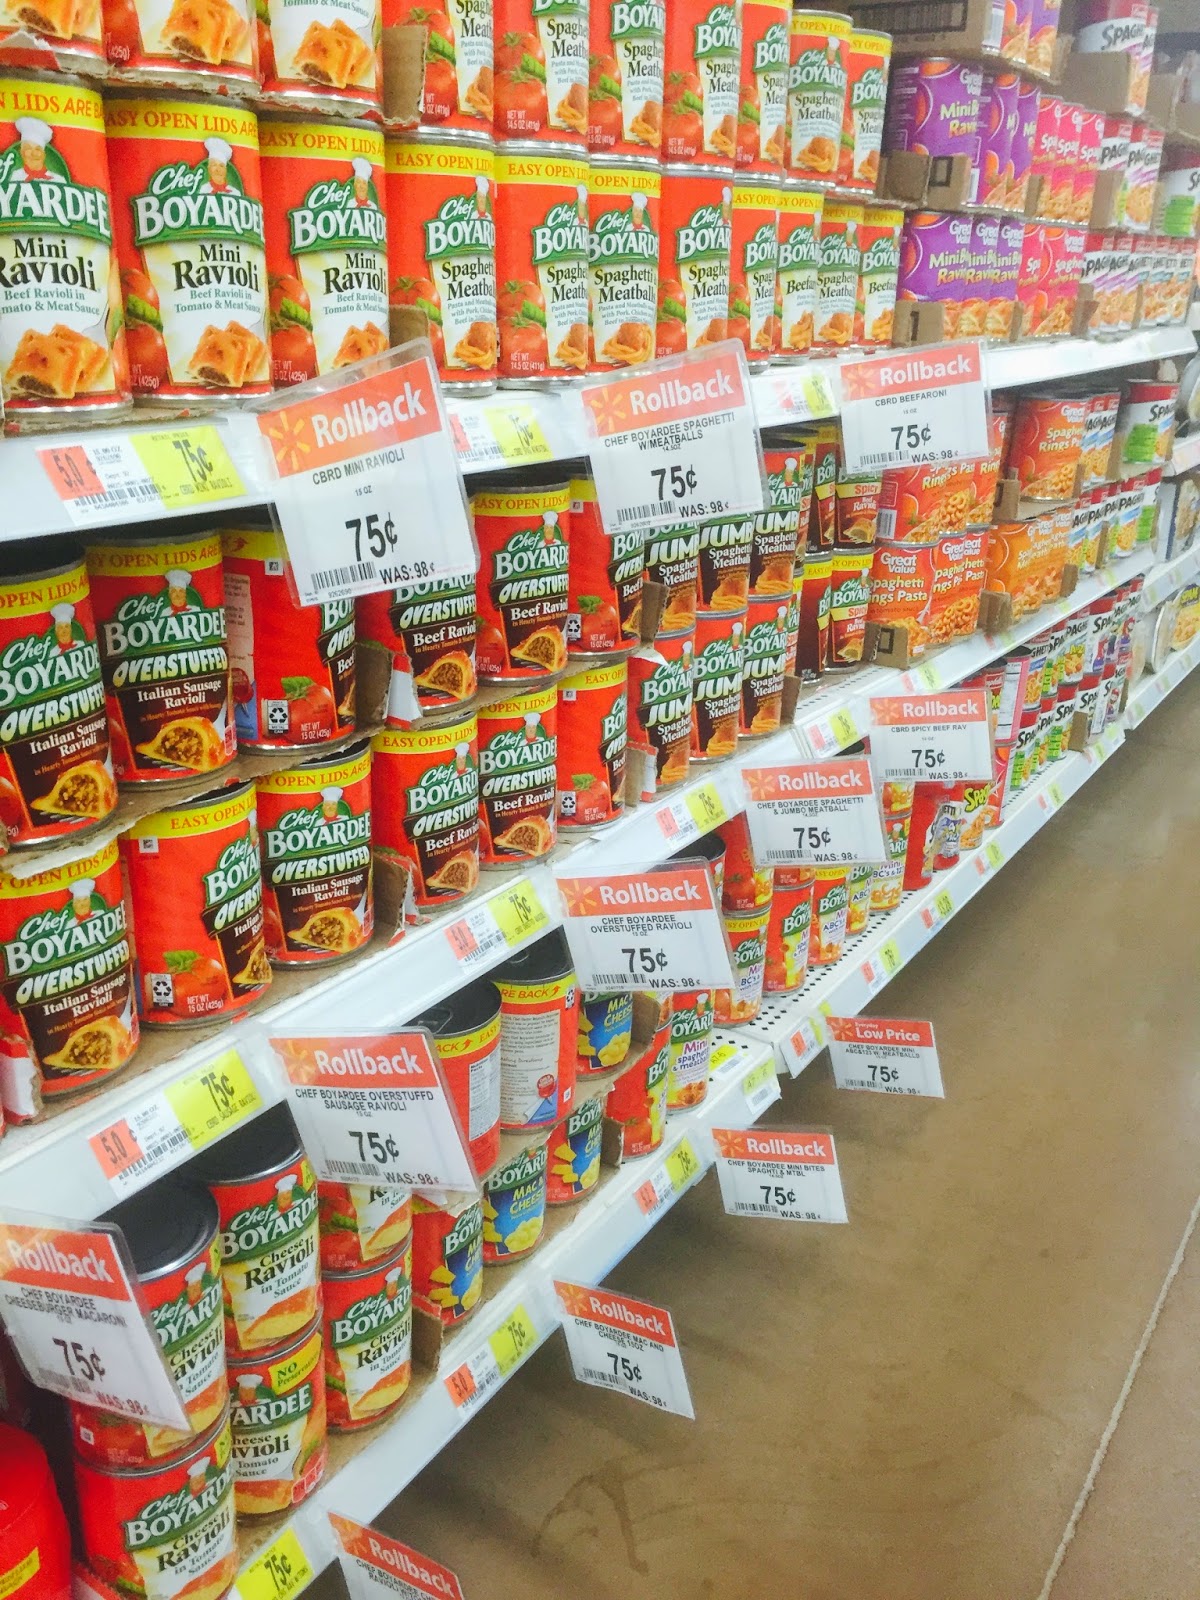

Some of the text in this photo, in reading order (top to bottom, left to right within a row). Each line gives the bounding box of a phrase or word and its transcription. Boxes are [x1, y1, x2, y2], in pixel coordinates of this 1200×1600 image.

[709, 7, 732, 25] Chef
[799, 50, 825, 66] Chef
[13, 92, 59, 112] LIDS
[144, 111, 237, 134] OPEN LIDS
[303, 135, 347, 151] OPEN
[396, 153, 473, 170] EASY OPEN
[508, 163, 542, 176] EASY
[152, 165, 202, 195] Chef
[595, 176, 629, 188] OPEN
[308, 183, 350, 209] Chef
[0, 183, 110, 237] YARDEE
[441, 200, 473, 220] Chef
[691, 206, 720, 228] Chef
[596, 212, 629, 233] Chef
[789, 228, 811, 243] Chef
[14, 237, 67, 260] Mini
[200, 244, 241, 263] Mini
[345, 253, 376, 271] Mini
[172, 259, 260, 293] Ravioli
[594, 265, 653, 285] Spaghetti
[880, 354, 972, 387] Rollback
[138, 376, 159, 389] (425g)
[630, 369, 734, 416] Rollback
[875, 390, 947, 407] CBRD BEEFARONI
[312, 382, 427, 448] Rollback
[604, 412, 735, 448] CHEF BOYARDEE SPAGHETTI
[891, 423, 932, 450] 75¢
[638, 430, 703, 451] W/MEATBALLS
[1039, 440, 1069, 452] Rings
[312, 448, 405, 485] CBRD MINI RAVIOLI
[912, 452, 939, 464] WAS:
[355, 486, 372, 497] 15 OZ
[651, 464, 698, 501] 75¢
[506, 498, 540, 509] OPEN
[679, 503, 708, 518] WAS:
[345, 512, 398, 562] 75¢
[508, 532, 541, 551] Chef
[881, 552, 917, 567] Great
[888, 563, 916, 574] Value
[380, 565, 414, 585] WAS:
[898, 591, 927, 601] Pasta
[118, 596, 164, 622] Chef
[511, 604, 541, 621] Beef
[413, 628, 446, 647] Beef
[751, 624, 774, 638] Chef
[3, 636, 51, 668] Chef
[704, 641, 729, 657] Chef
[112, 647, 228, 687] OVERSTUFFED
[137, 685, 181, 702] Italian
[165, 692, 206, 709] Ravioli
[902, 699, 979, 718] Rollback
[301, 723, 313, 732] NET
[29, 729, 76, 755] Italian
[60, 732, 97, 757] Ravioli
[383, 732, 452, 748] EASY OPEN
[491, 731, 522, 749] Chef
[911, 749, 945, 768] 75¢
[275, 774, 316, 787] OPEN
[420, 766, 453, 787] Chef
[778, 769, 864, 792] Rollback
[929, 772, 951, 780] WAS:
[493, 795, 524, 812] Beef
[757, 797, 864, 809] CHEF BOYARDEE SPAGHETTI
[170, 814, 210, 830] EASY
[280, 809, 319, 830] Chef
[425, 834, 455, 852] Beef
[793, 827, 831, 848] 75¢
[272, 846, 370, 884] OVERSTUFFED
[814, 853, 839, 862] WAS:
[291, 882, 329, 897] Italian
[313, 886, 349, 902] Ravioli
[600, 880, 702, 905] Rollback
[20, 909, 68, 941] Chef
[591, 922, 692, 934] OVERSTUFFED RAVIOLI
[601, 915, 676, 925] CHEF BOYARDEE
[621, 948, 668, 973] 75¢
[650, 979, 679, 989] WAS:
[187, 994, 210, 1005] NET WT
[518, 989, 548, 998] BACK
[43, 992, 89, 1016] Italian
[72, 990, 112, 1018] Ravioli
[206, 1000, 224, 1011] (425g)
[608, 998, 629, 1014] MAC
[856, 1027, 921, 1041] Low Price
[684, 1039, 708, 1055] Mini
[314, 1047, 424, 1076] Rollback
[868, 1065, 899, 1083] 75¢
[295, 1089, 434, 1101] CHEF BOYARDEE OVERSTUFFD
[885, 1086, 905, 1094] WAS:
[324, 1100, 407, 1111] SAUSAGE RAVIOLI
[348, 1131, 400, 1164] 75¢
[746, 1138, 826, 1157] Rollback
[728, 1159, 746, 1167] CHEF
[748, 1167, 778, 1175] SPAGHTI
[384, 1172, 416, 1184] WAS:
[513, 1186, 537, 1202] MAC
[760, 1185, 796, 1206] 75¢
[231, 1204, 273, 1231] Chef
[780, 1210, 804, 1219] WAS:
[5, 1238, 114, 1283] Rollback
[20, 1287, 97, 1311] CHEF BOYARDEE
[4, 1294, 128, 1328] CHEESEBURGER MACARONI
[589, 1297, 666, 1336] Rollback
[575, 1319, 664, 1352] CHEF BOYARDEE MAC AND
[599, 1330, 645, 1352] CHEESE 15OZ
[52, 1337, 105, 1382] 75¢
[607, 1352, 643, 1382] 75¢
[277, 1362, 298, 1379] NO
[629, 1386, 652, 1402] WAS:
[356, 1558, 376, 1573] CHEF
[368, 1537, 455, 1598] Rollback
[368, 1572, 399, 1592] RAVIOLI
